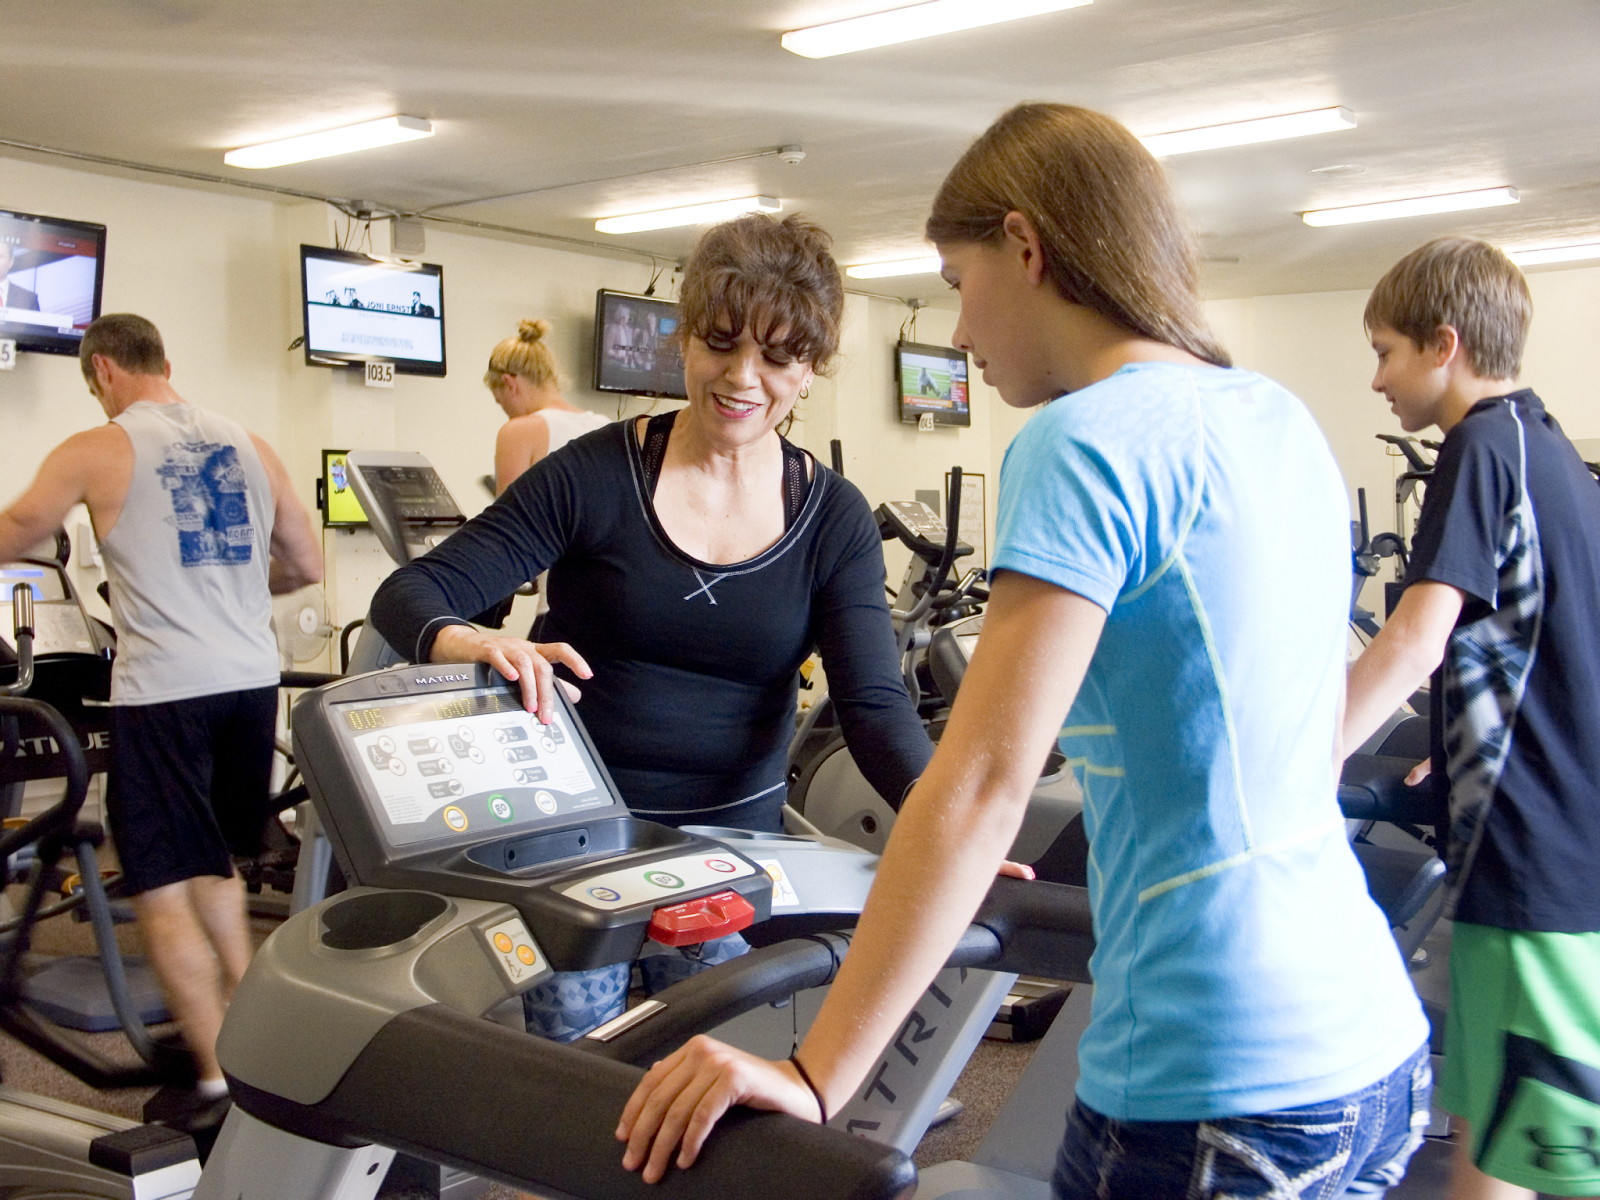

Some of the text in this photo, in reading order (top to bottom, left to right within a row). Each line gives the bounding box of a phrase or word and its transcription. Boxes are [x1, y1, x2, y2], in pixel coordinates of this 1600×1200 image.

[366, 301, 411, 313] JONI ERNST
[367, 364, 392, 382] 103.5
[920, 417, 934, 429] 104.5
[415, 673, 469, 686] MATRIX
[495, 804, 507, 815] go
[654, 875, 672, 885] go
[846, 966, 968, 1138] ATRI
